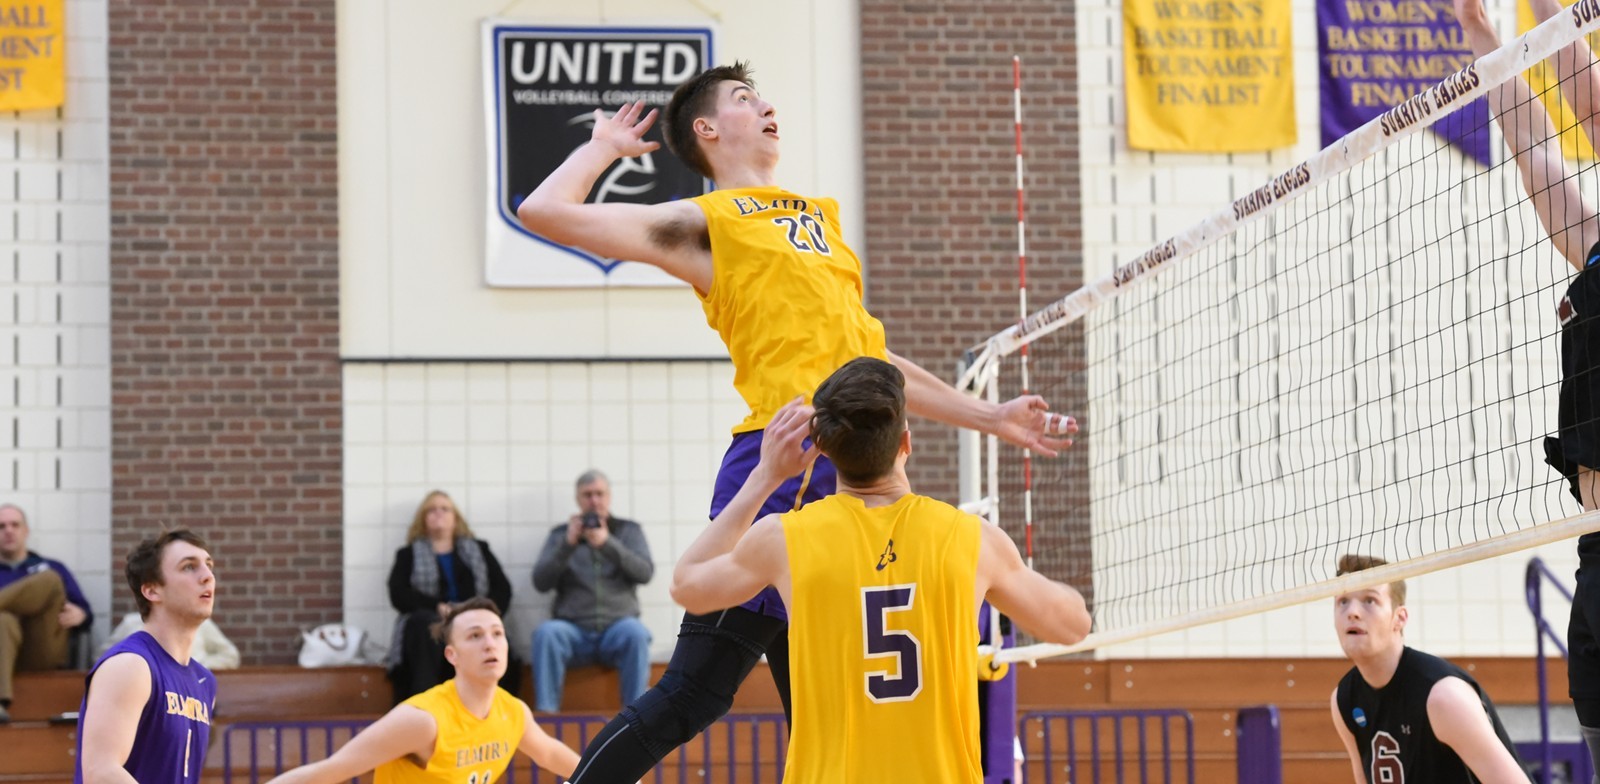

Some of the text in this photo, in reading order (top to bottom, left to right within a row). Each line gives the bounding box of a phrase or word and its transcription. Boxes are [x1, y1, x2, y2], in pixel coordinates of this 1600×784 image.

[1133, 26, 1280, 49] BASKETBALL
[1327, 25, 1472, 51] BASKETBALL
[510, 42, 699, 84] UNITED
[1136, 53, 1285, 78] TOURNAMENT
[513, 89, 601, 105] VOLLEYBALL
[1157, 83, 1261, 106] FINALIST
[1351, 81, 1430, 107] FINAL
[772, 212, 832, 256] 20
[860, 582, 923, 704] 5
[183, 728, 192, 778] 1
[1371, 730, 1405, 784] 6
